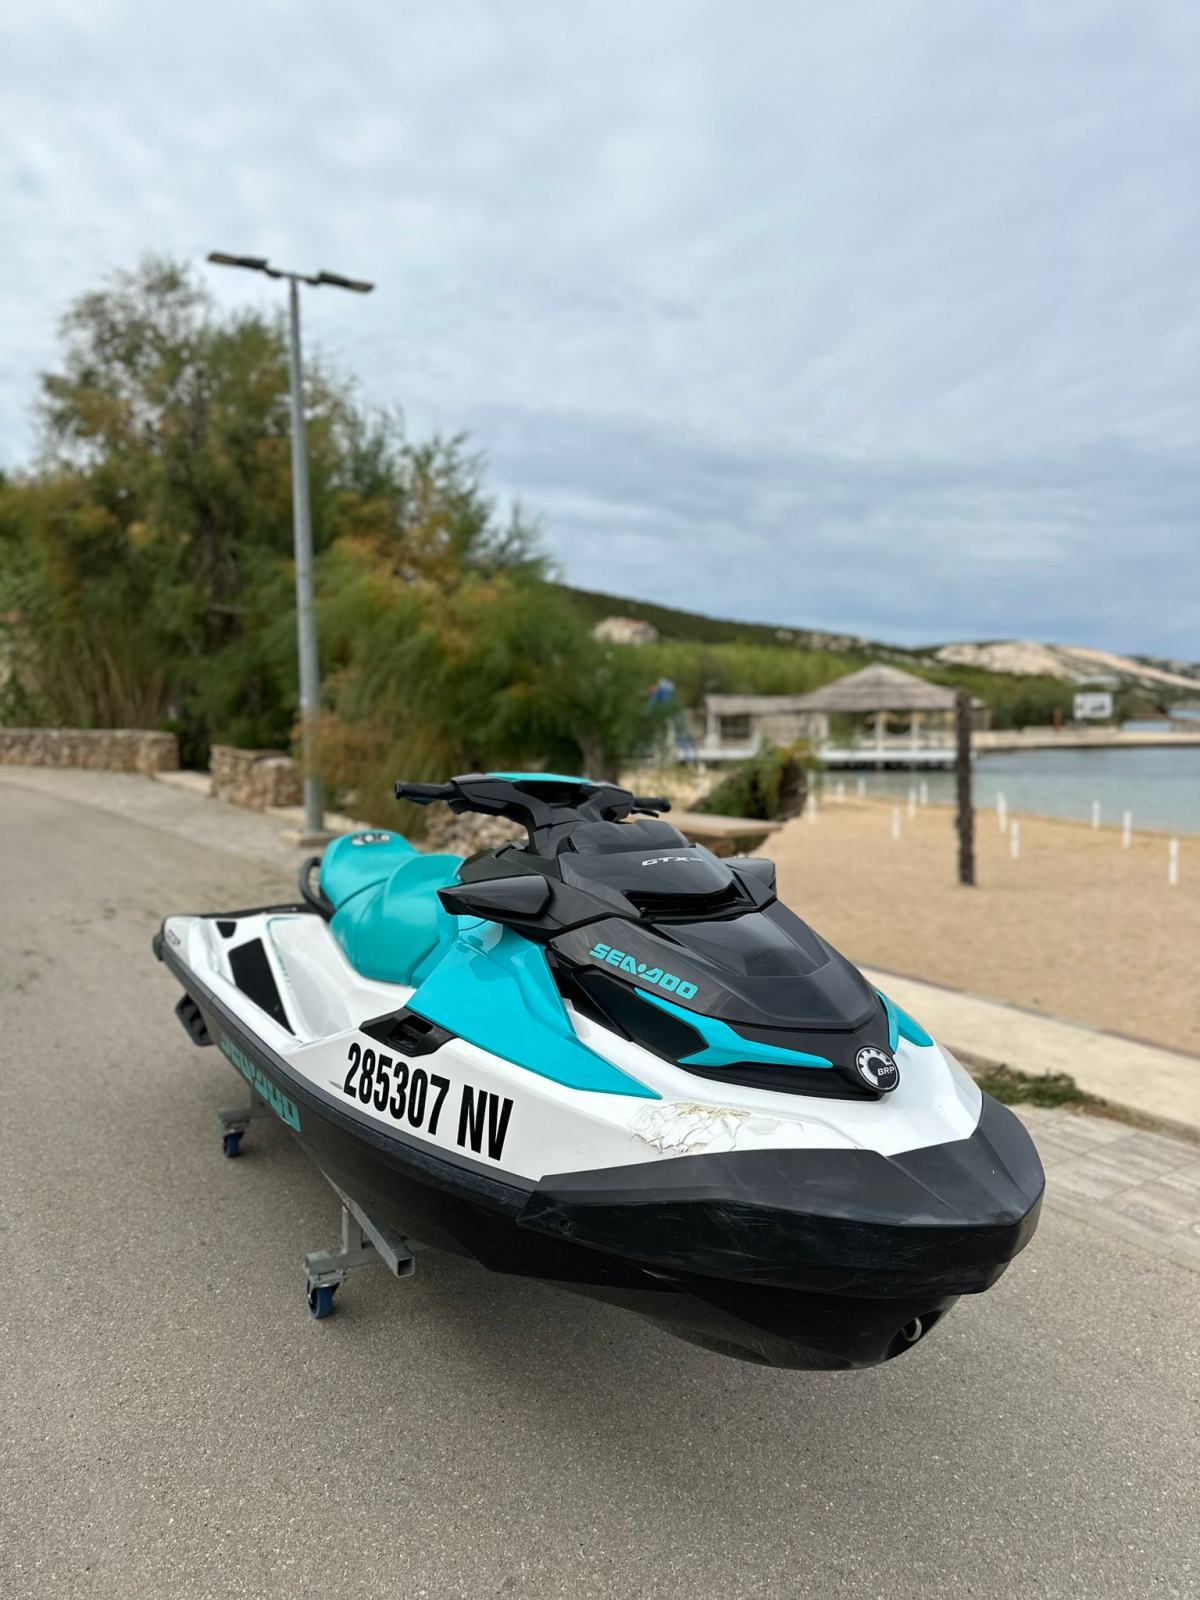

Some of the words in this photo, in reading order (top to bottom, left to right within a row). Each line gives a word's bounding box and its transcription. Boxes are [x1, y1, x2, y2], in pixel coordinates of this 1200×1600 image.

[641, 856, 689, 867] GTX
[877, 1066, 895, 1076] BRP
[343, 1042, 451, 1136] 285307
[456, 1083, 514, 1161] NV
